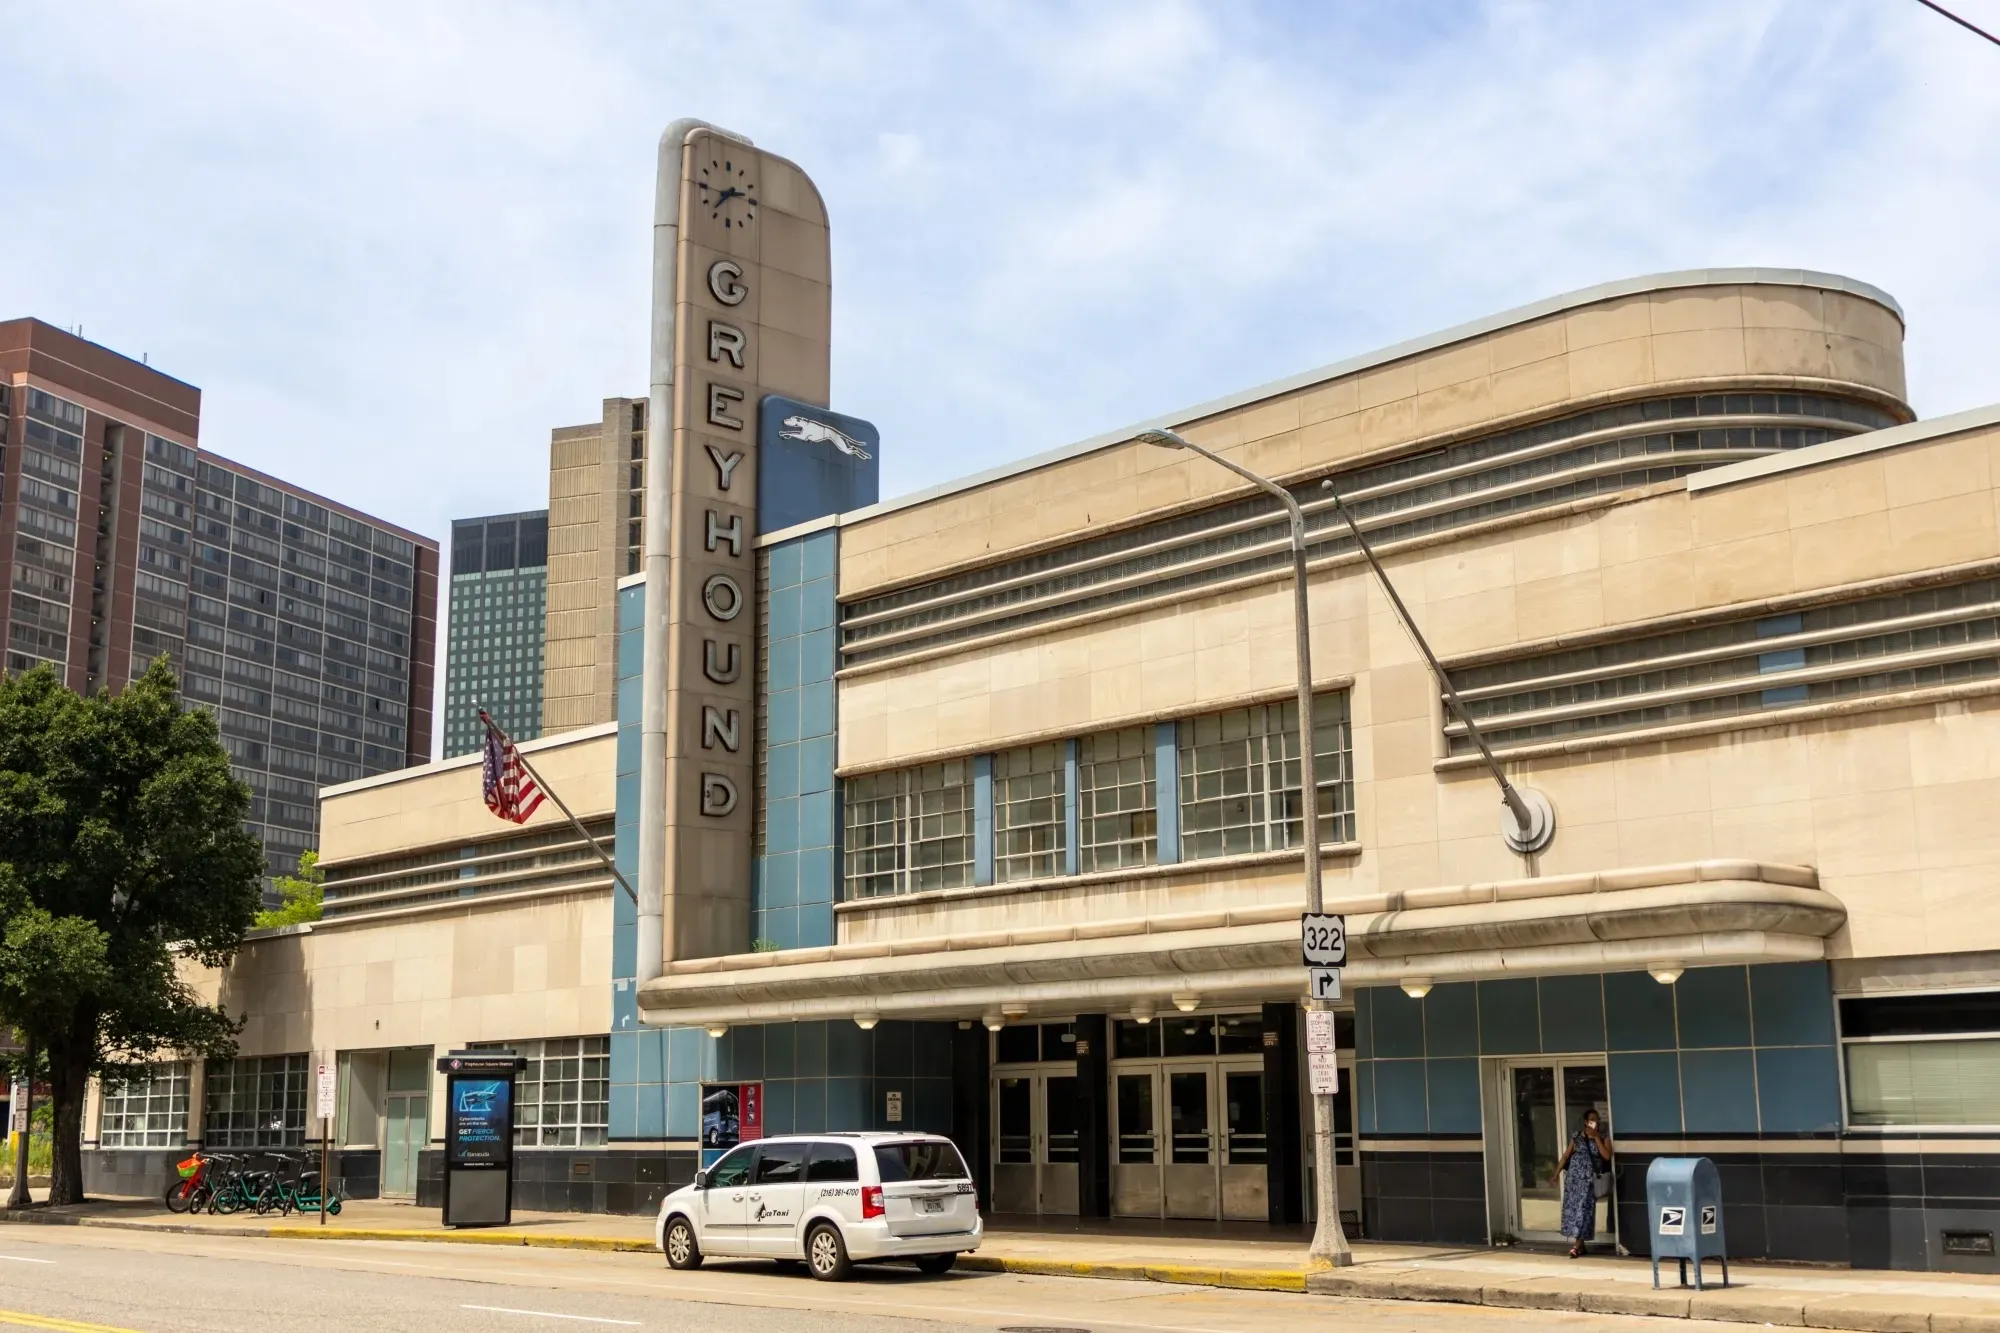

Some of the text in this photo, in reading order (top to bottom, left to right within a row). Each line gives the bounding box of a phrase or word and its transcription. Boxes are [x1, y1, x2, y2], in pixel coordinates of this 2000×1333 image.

[700, 259, 749, 817] GREYHOUND
[1307, 926, 1341, 950] 322
[820, 1188, 859, 1197] (216) 361-4700
[773, 1209, 790, 1217] Taxi
